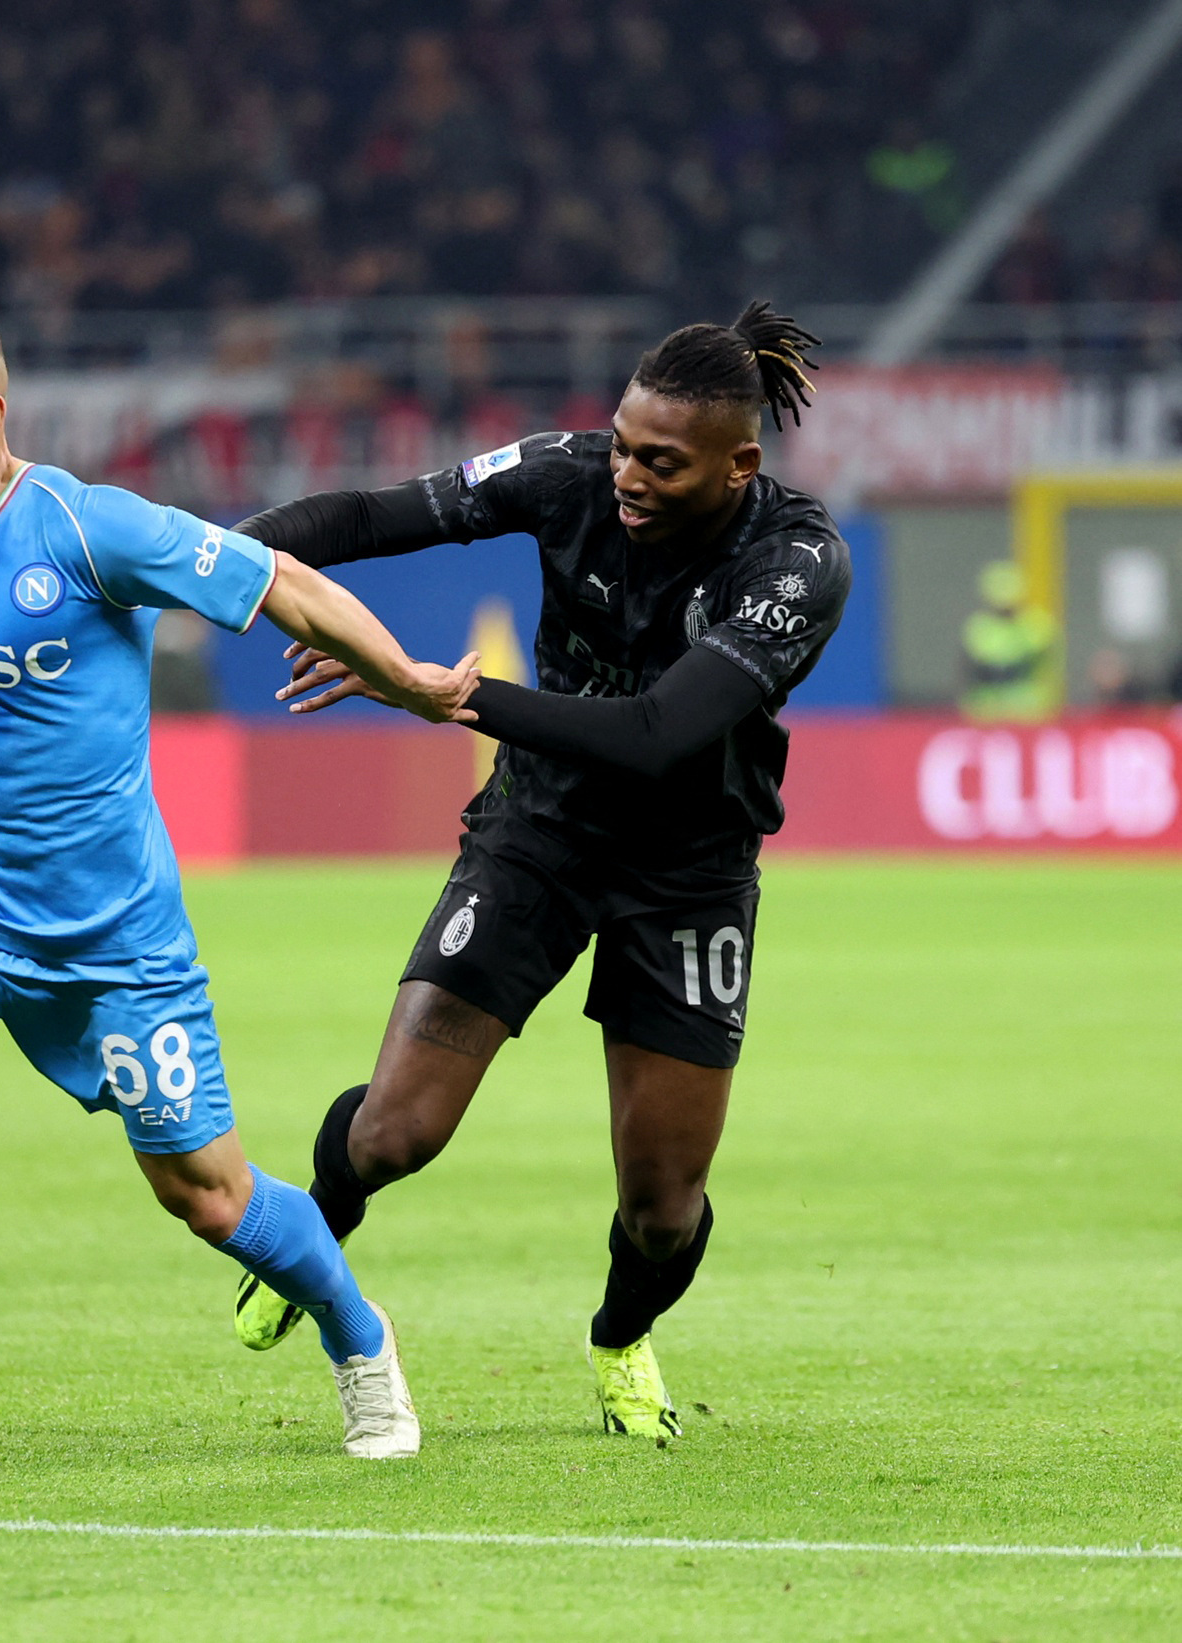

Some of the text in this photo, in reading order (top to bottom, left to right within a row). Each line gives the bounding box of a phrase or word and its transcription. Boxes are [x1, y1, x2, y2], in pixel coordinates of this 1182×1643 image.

[194, 523, 223, 577] eba
[25, 576, 49, 602] N
[736, 595, 808, 635] MSC
[919, 727, 1177, 839] CLUB
[672, 926, 744, 1005] 10
[101, 1022, 196, 1106] 68
[138, 1097, 192, 1125] EA7
